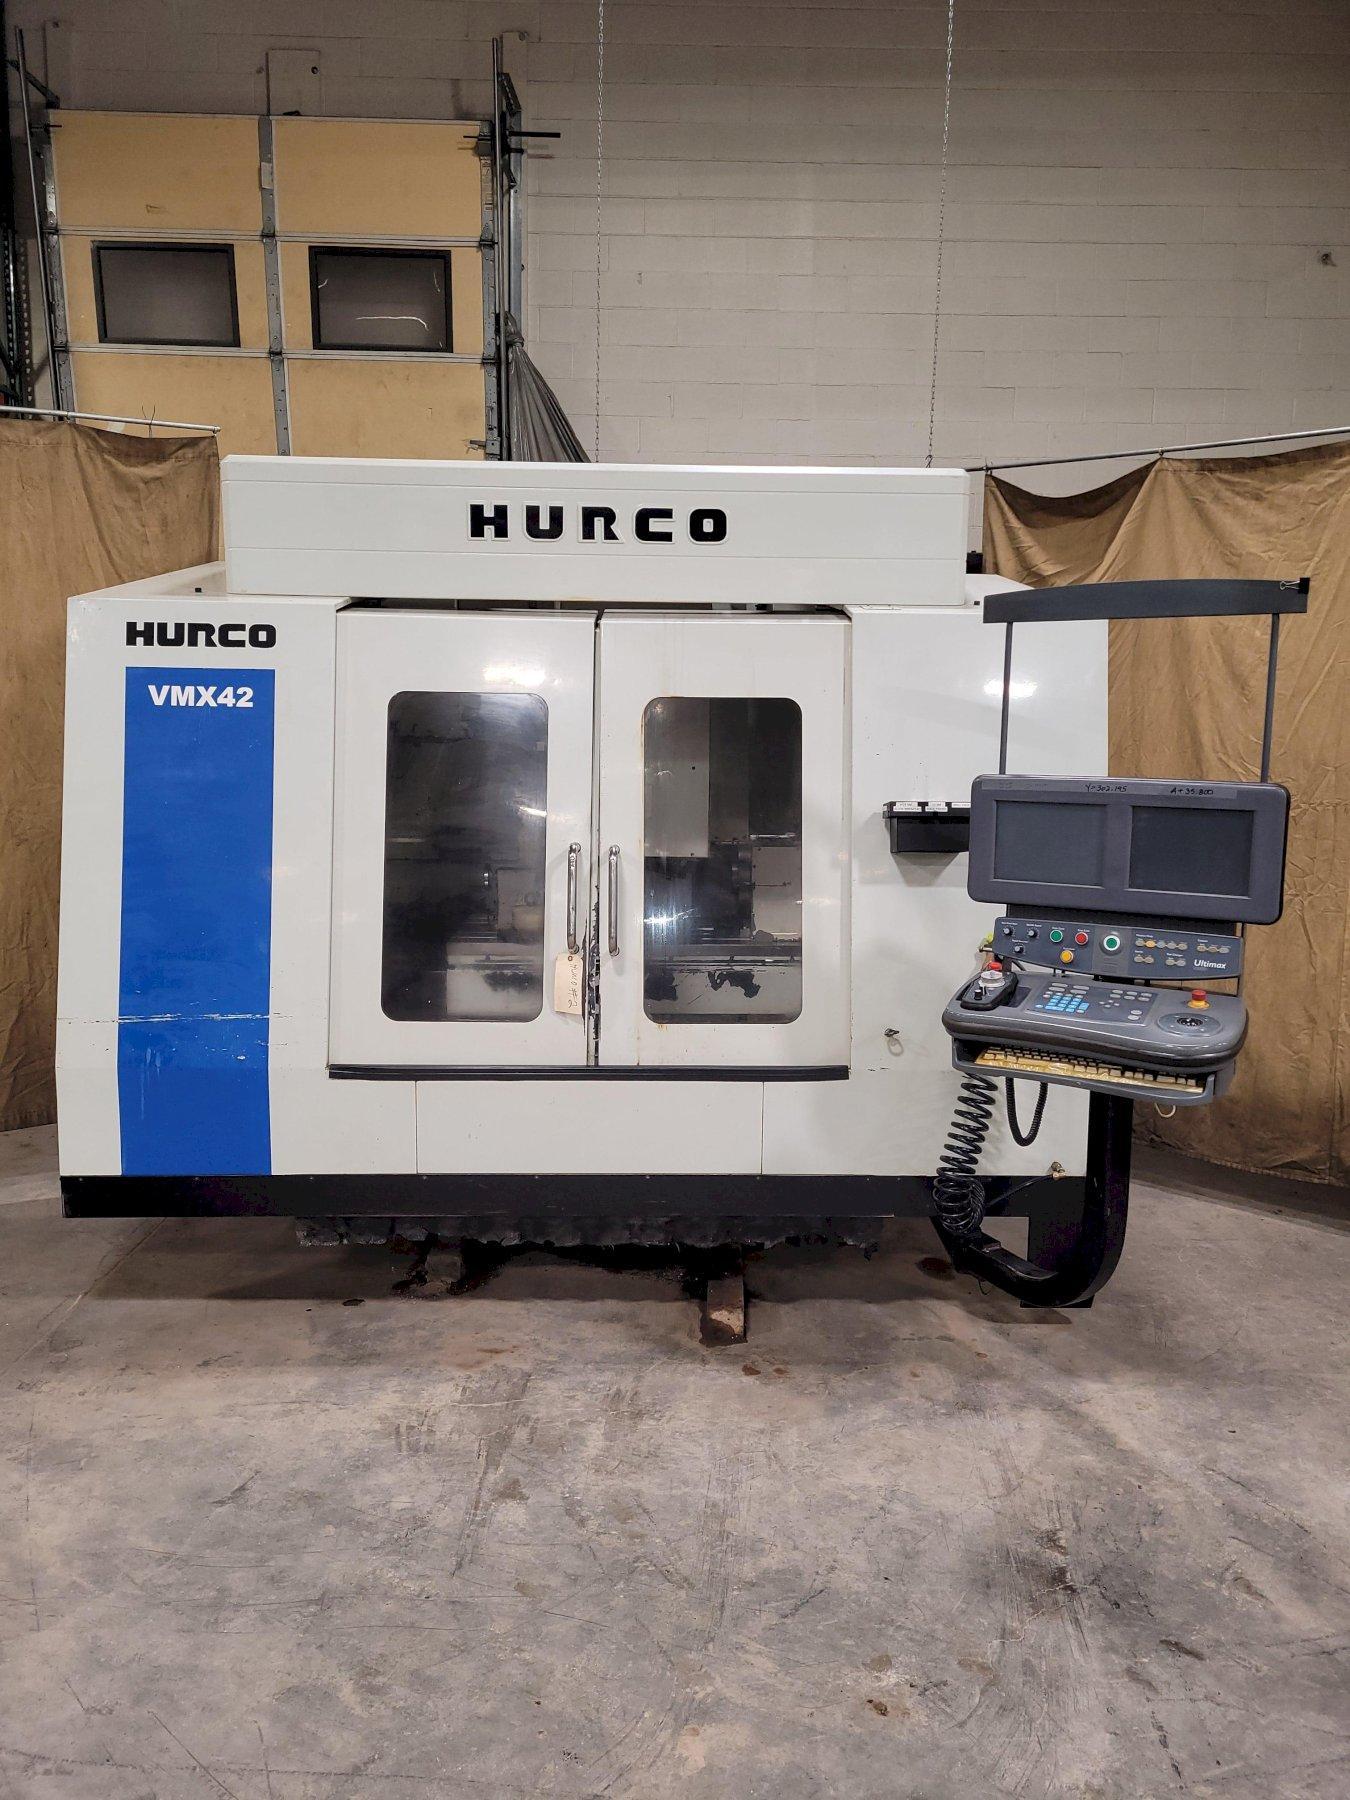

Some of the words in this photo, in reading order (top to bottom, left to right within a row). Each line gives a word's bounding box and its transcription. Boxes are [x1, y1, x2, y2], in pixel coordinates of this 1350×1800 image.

[470, 503, 727, 543] HURCO
[126, 621, 277, 648] HURCO
[147, 684, 254, 708] VMX42
[1193, 959, 1227, 970] Ultimax
